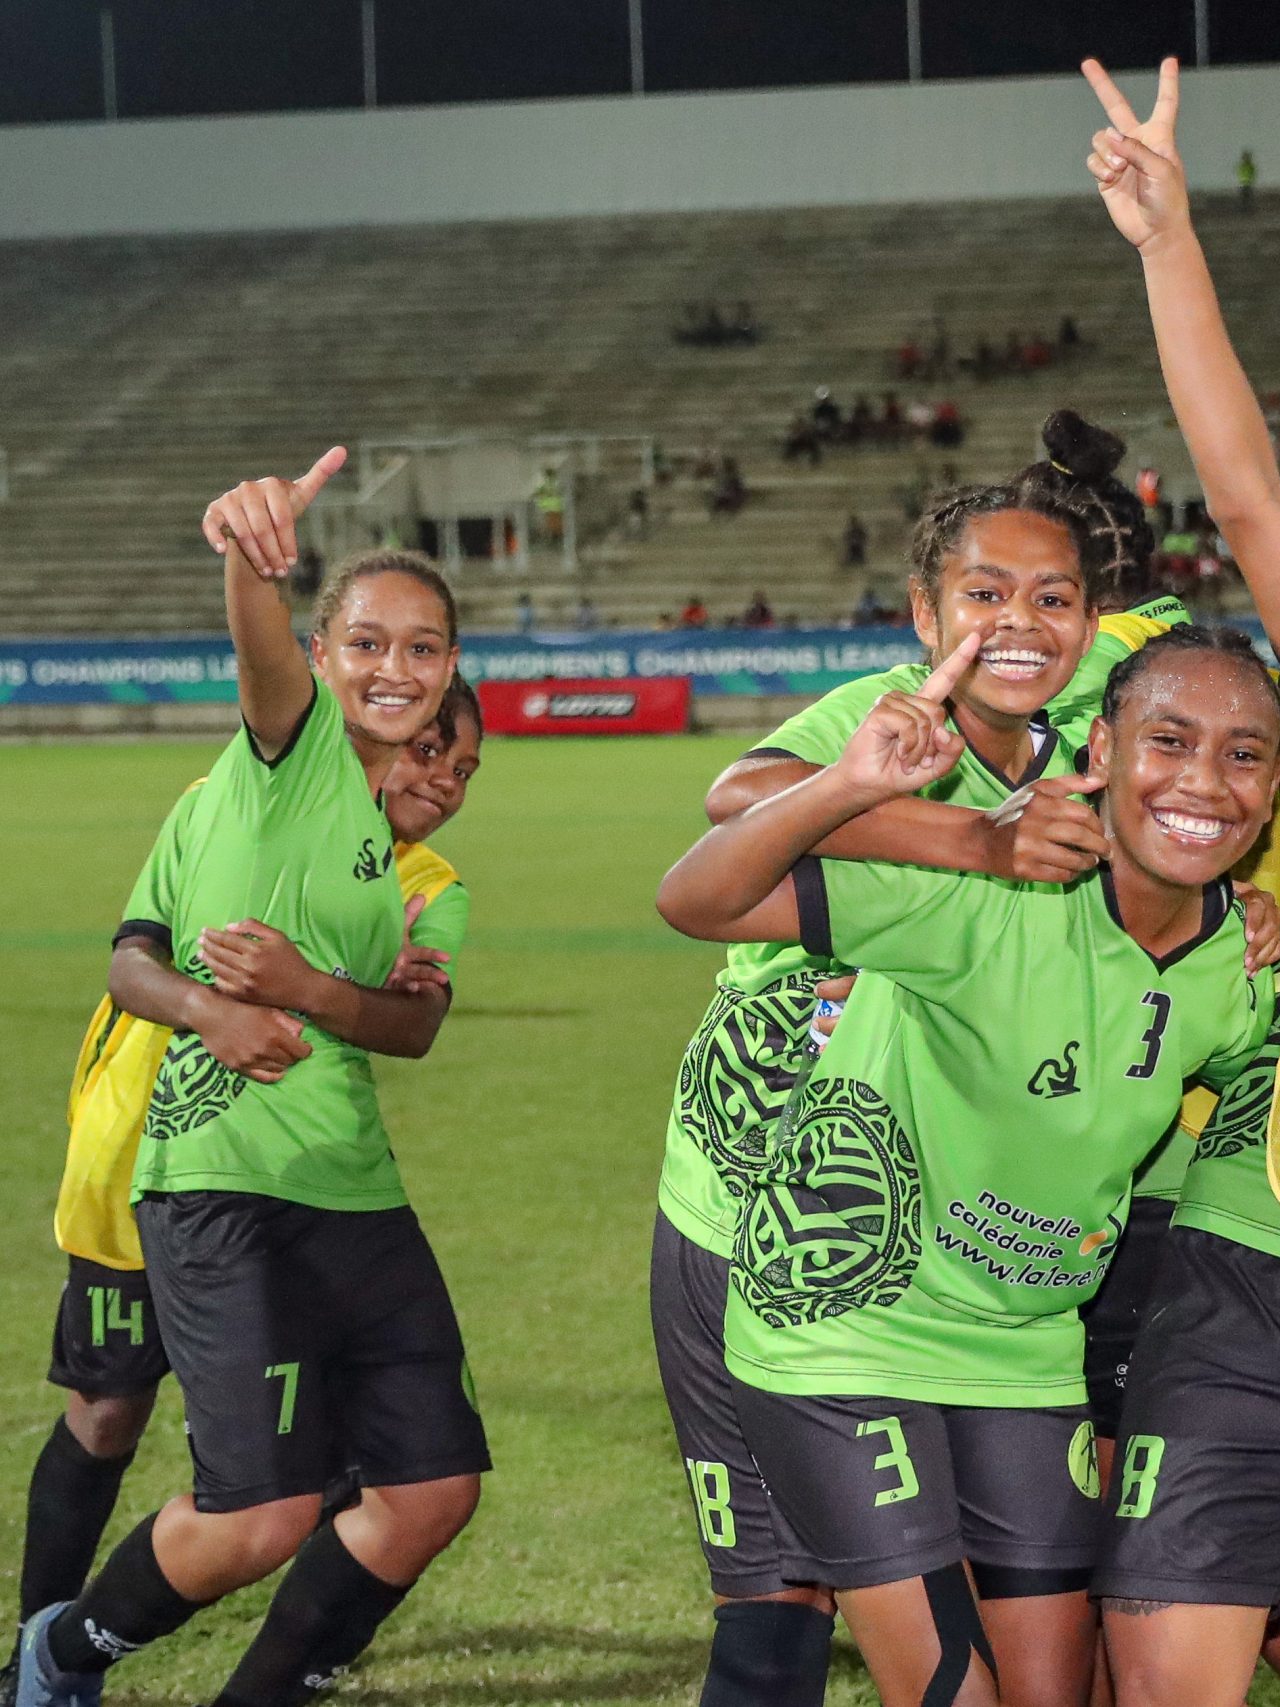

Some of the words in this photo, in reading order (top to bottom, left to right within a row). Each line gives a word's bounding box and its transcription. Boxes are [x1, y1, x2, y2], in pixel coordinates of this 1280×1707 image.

[32, 657, 205, 687] CHAMPIONS
[635, 645, 821, 676] CHAMPIONS
[1124, 990, 1172, 1080] 3
[948, 1200, 1065, 1260] calédonie
[977, 1189, 1082, 1239] nouvelle
[934, 1224, 1107, 1288] www.la1ere.n
[87, 1286, 145, 1347] 14
[264, 1361, 301, 1435] 7
[855, 1416, 920, 1507] 3
[1115, 1434, 1166, 1519] 8
[686, 1457, 737, 1548] 18
